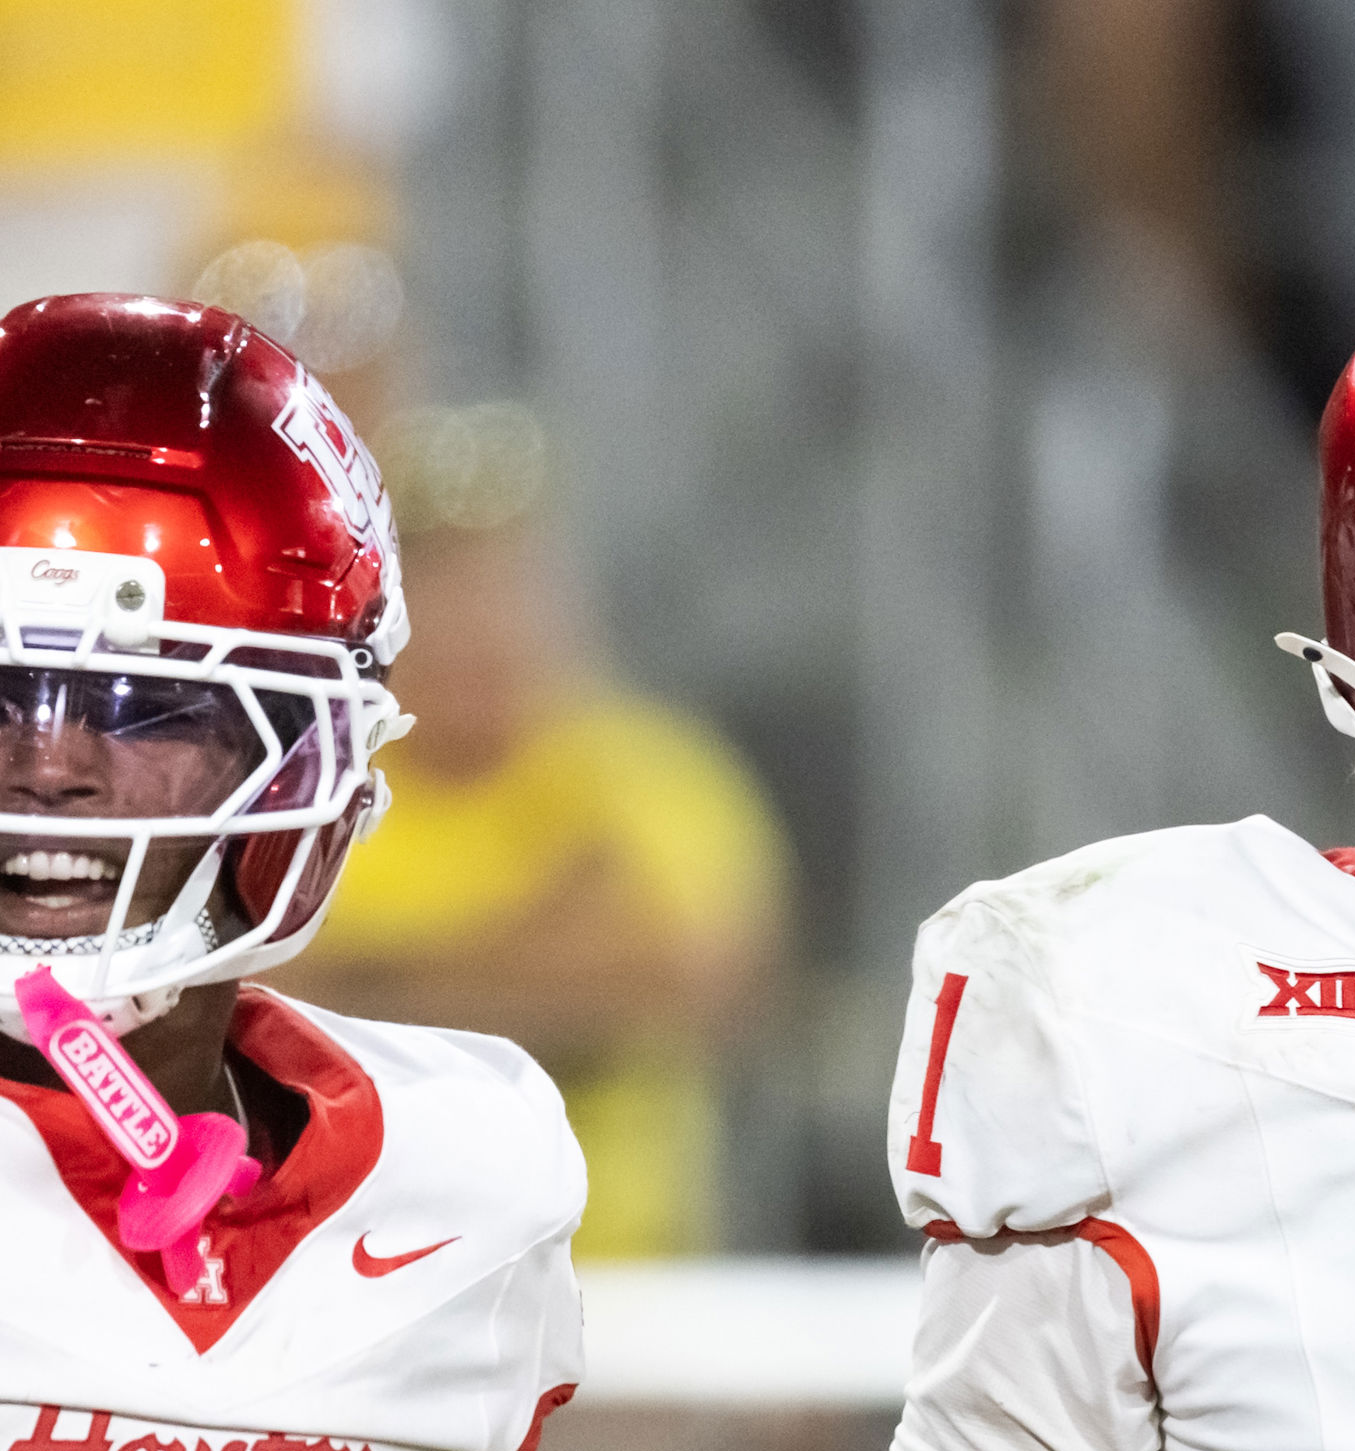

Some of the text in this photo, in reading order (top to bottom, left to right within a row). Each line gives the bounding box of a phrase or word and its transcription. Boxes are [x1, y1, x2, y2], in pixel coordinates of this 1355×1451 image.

[30, 559, 80, 586] Coogs
[61, 1031, 170, 1157] BATTLE
[906, 972, 968, 1178] 1
